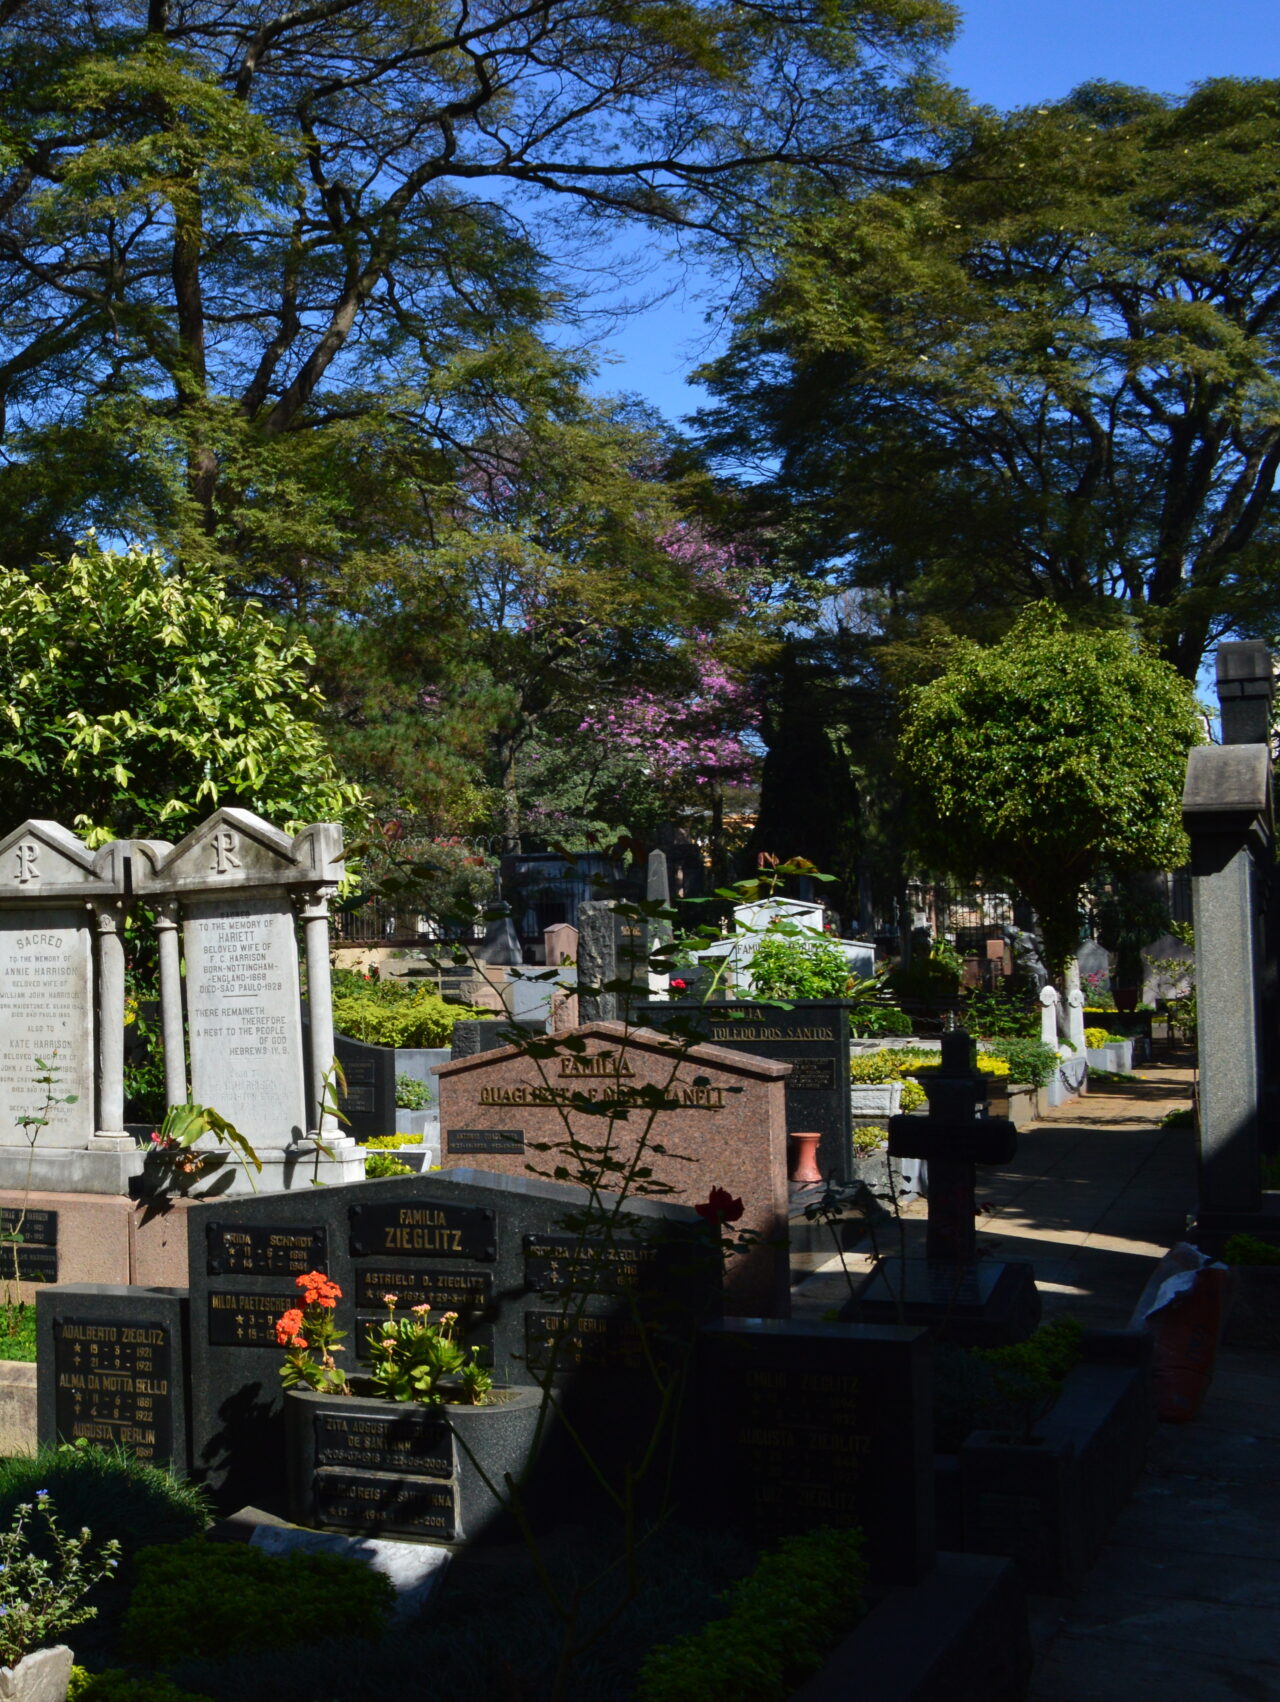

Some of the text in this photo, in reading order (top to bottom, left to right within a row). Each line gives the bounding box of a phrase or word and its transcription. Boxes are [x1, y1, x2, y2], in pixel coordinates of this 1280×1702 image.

[200, 919, 274, 931] TO THE MEMORY OF
[16, 934, 63, 949] SACRED
[218, 931, 255, 943] HARIETT
[203, 942, 272, 954] BELOVED WIFE OF
[35, 955, 60, 963] MEMORY
[229, 953, 266, 963] HARRISON
[5, 967, 79, 976] ANNIE HARRISON
[12, 980, 40, 988] BELOVED
[43, 980, 58, 988] WIFE
[195, 1006, 265, 1017] THERE REMAINETH
[241, 1016, 287, 1026] THEREFORE
[204, 1028, 223, 1037] REST
[226, 1027, 236, 1036] TO
[239, 1027, 253, 1036] THE
[255, 1026, 285, 1035] PEOPLE
[712, 1027, 756, 1041] TOLEDO
[760, 1027, 781, 1041] DOS
[9, 1040, 72, 1049] KATE HARRISON
[259, 1036, 287, 1045] OF GOD
[229, 1047, 267, 1056] HEBREWS
[560, 1056, 635, 1076] FAMILIA
[399, 1209, 447, 1226] FAMILIA
[269, 1235, 314, 1248] SCHMIDT
[384, 1227, 463, 1251] ZIEGLITZ
[437, 1276, 485, 1289] ZIEGLITZ
[62, 1325, 164, 1345] ADALBERTO ZIEGLITZ
[60, 1373, 168, 1396] ALMA DA MOTTA BELLO
[72, 1422, 114, 1441] AUGUSTA
